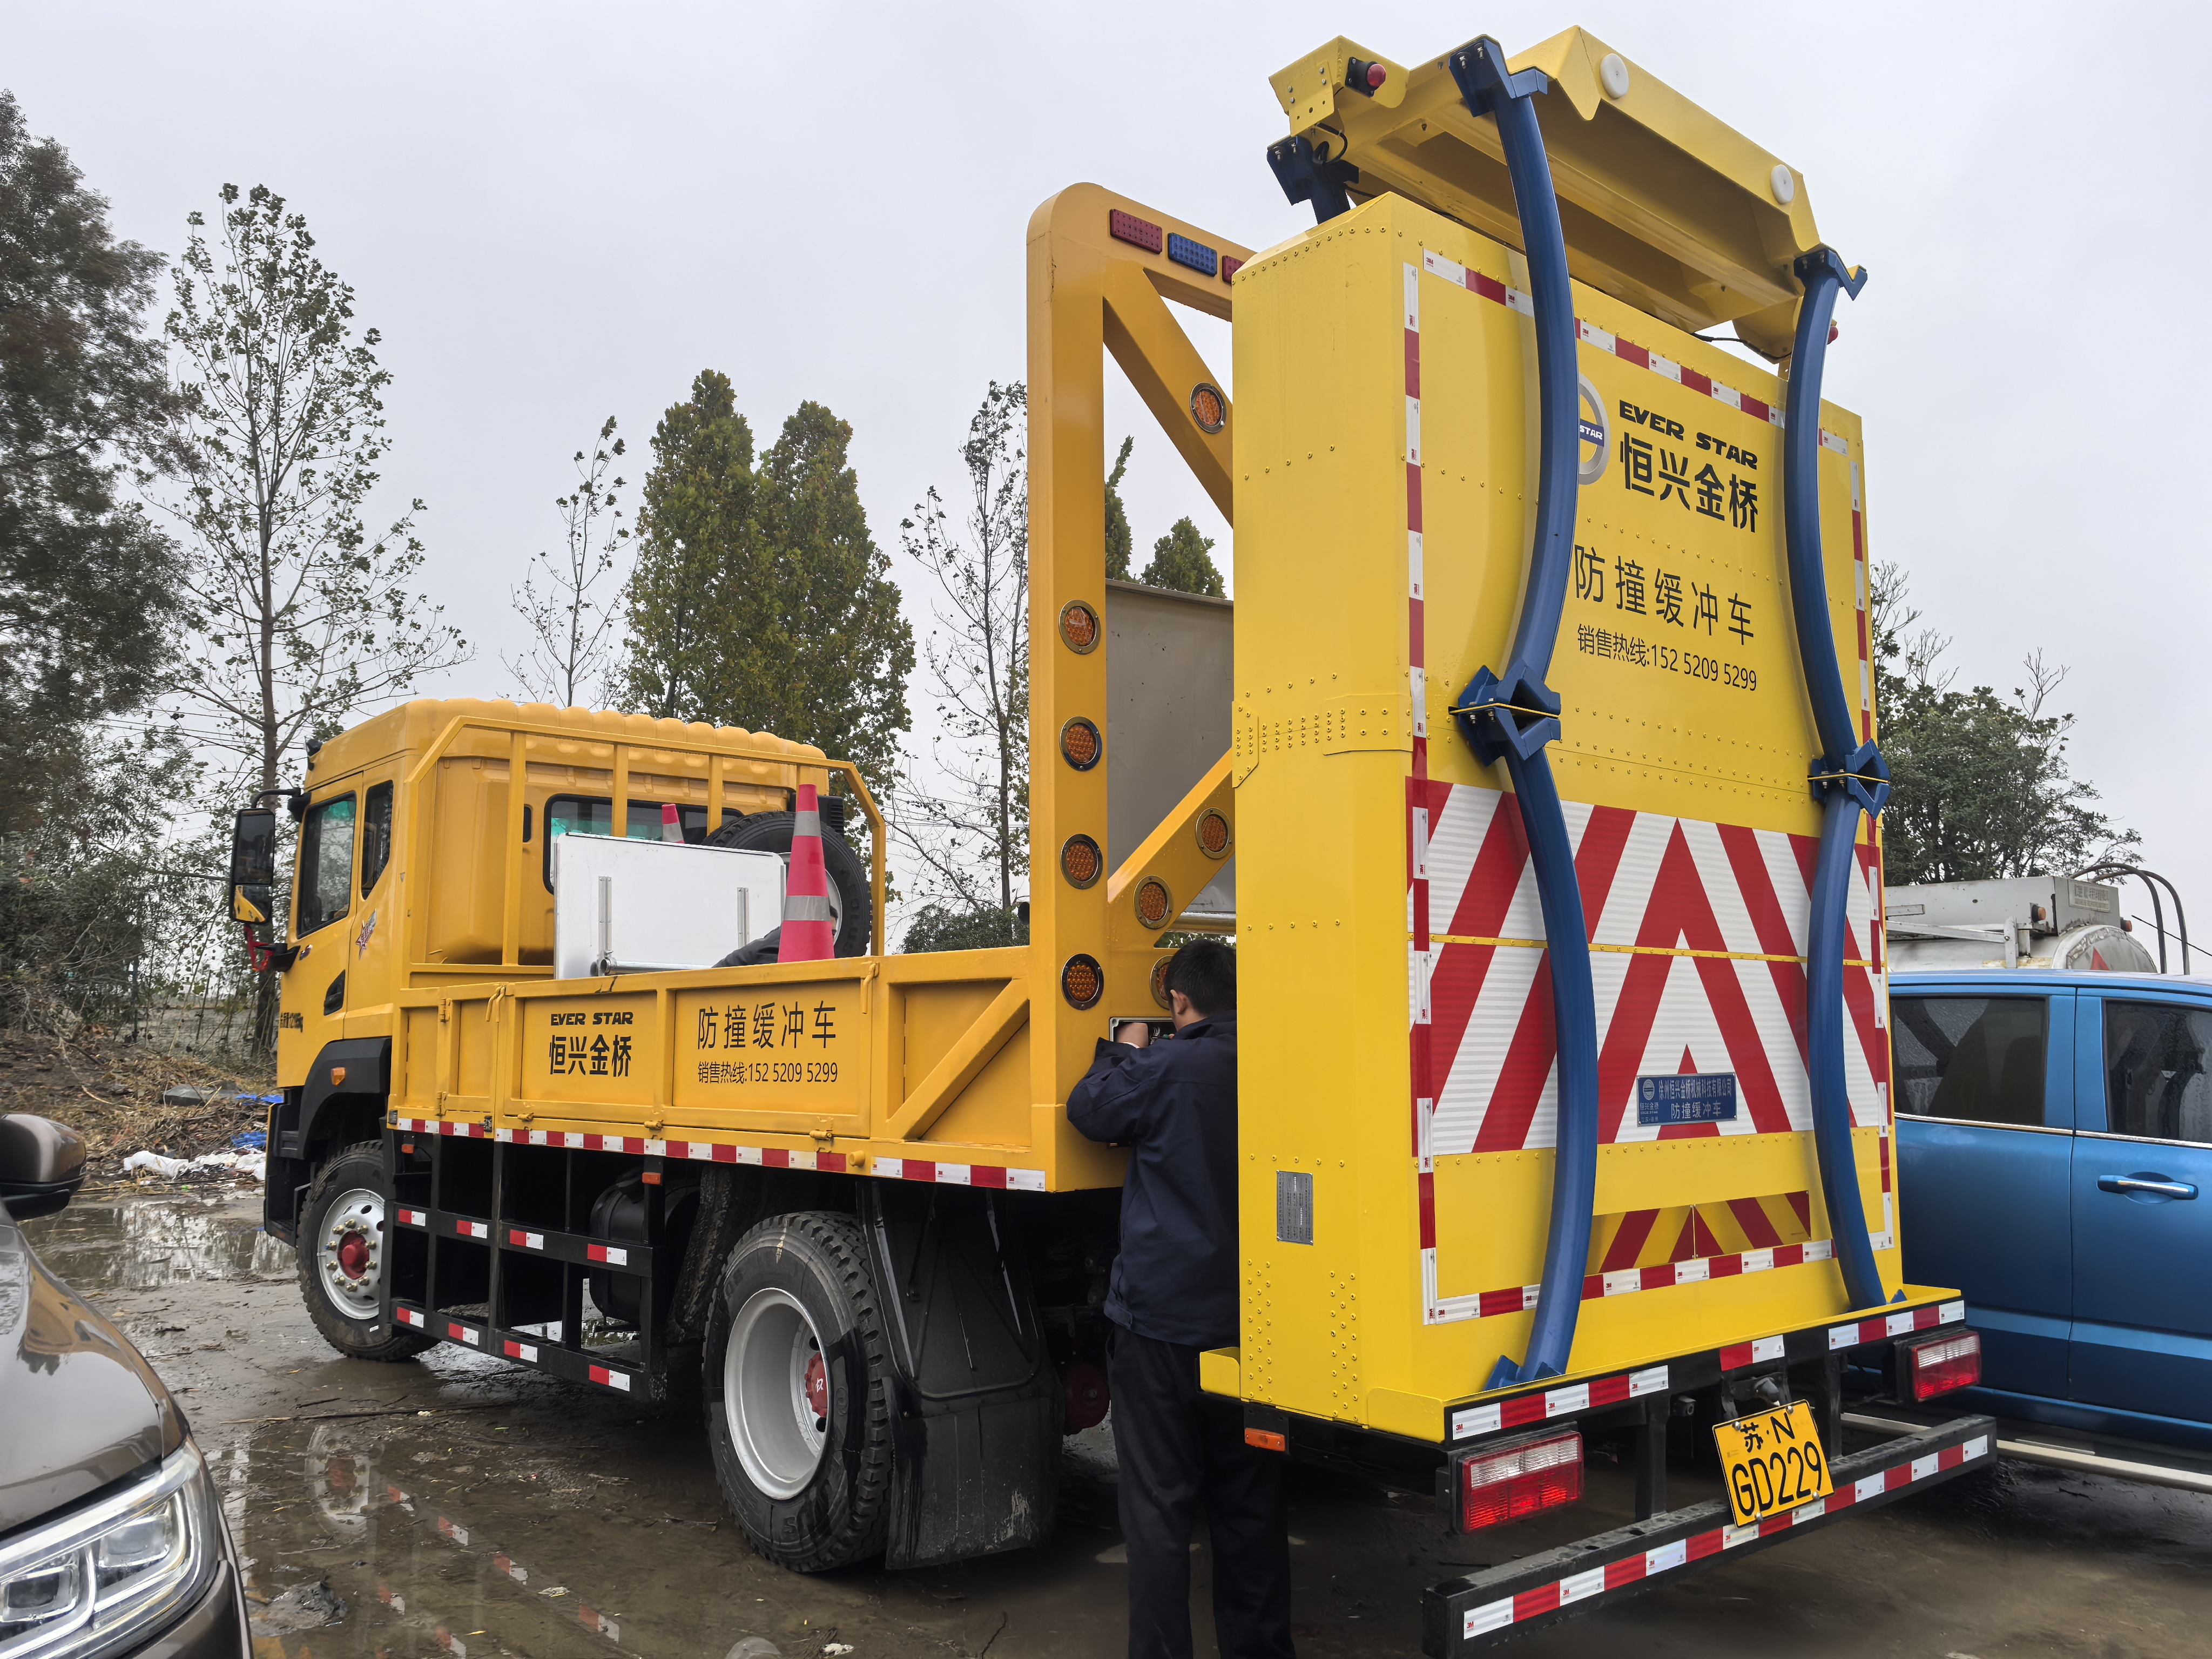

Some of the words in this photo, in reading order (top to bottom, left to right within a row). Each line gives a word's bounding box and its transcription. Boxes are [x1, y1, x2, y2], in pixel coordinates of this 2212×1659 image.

[1580, 424, 1603, 440] STAR
[1620, 400, 1684, 441] EVER
[1696, 433, 1758, 470] STAR
[1620, 431, 1758, 532] 恒兴金桥
[1574, 544, 1754, 645] 防撞缓冲车
[1577, 624, 1678, 672] 销售热线:152
[1684, 652, 1718, 682] 5209
[1724, 663, 1757, 691] 5299
[551, 1013, 586, 1026] EVER
[593, 1012, 633, 1024] STAR
[698, 1001, 835, 1049] 防撞缓冲车
[549, 1034, 631, 1077] 恒兴金桥
[698, 1061, 768, 1084] 销售热线:152
[773, 1063, 801, 1082] 5209
[807, 1062, 837, 1082] 5299
[1640, 1102, 1658, 1110] 恒兴金桥
[1658, 1078, 1731, 1100] 徐州恒兴金桥机械科技有限公司
[1671, 1101, 1721, 1119] 防撞缓冲车
[1740, 1412, 1795, 1453] 苏·N
[1732, 1441, 1822, 1516] GD229
